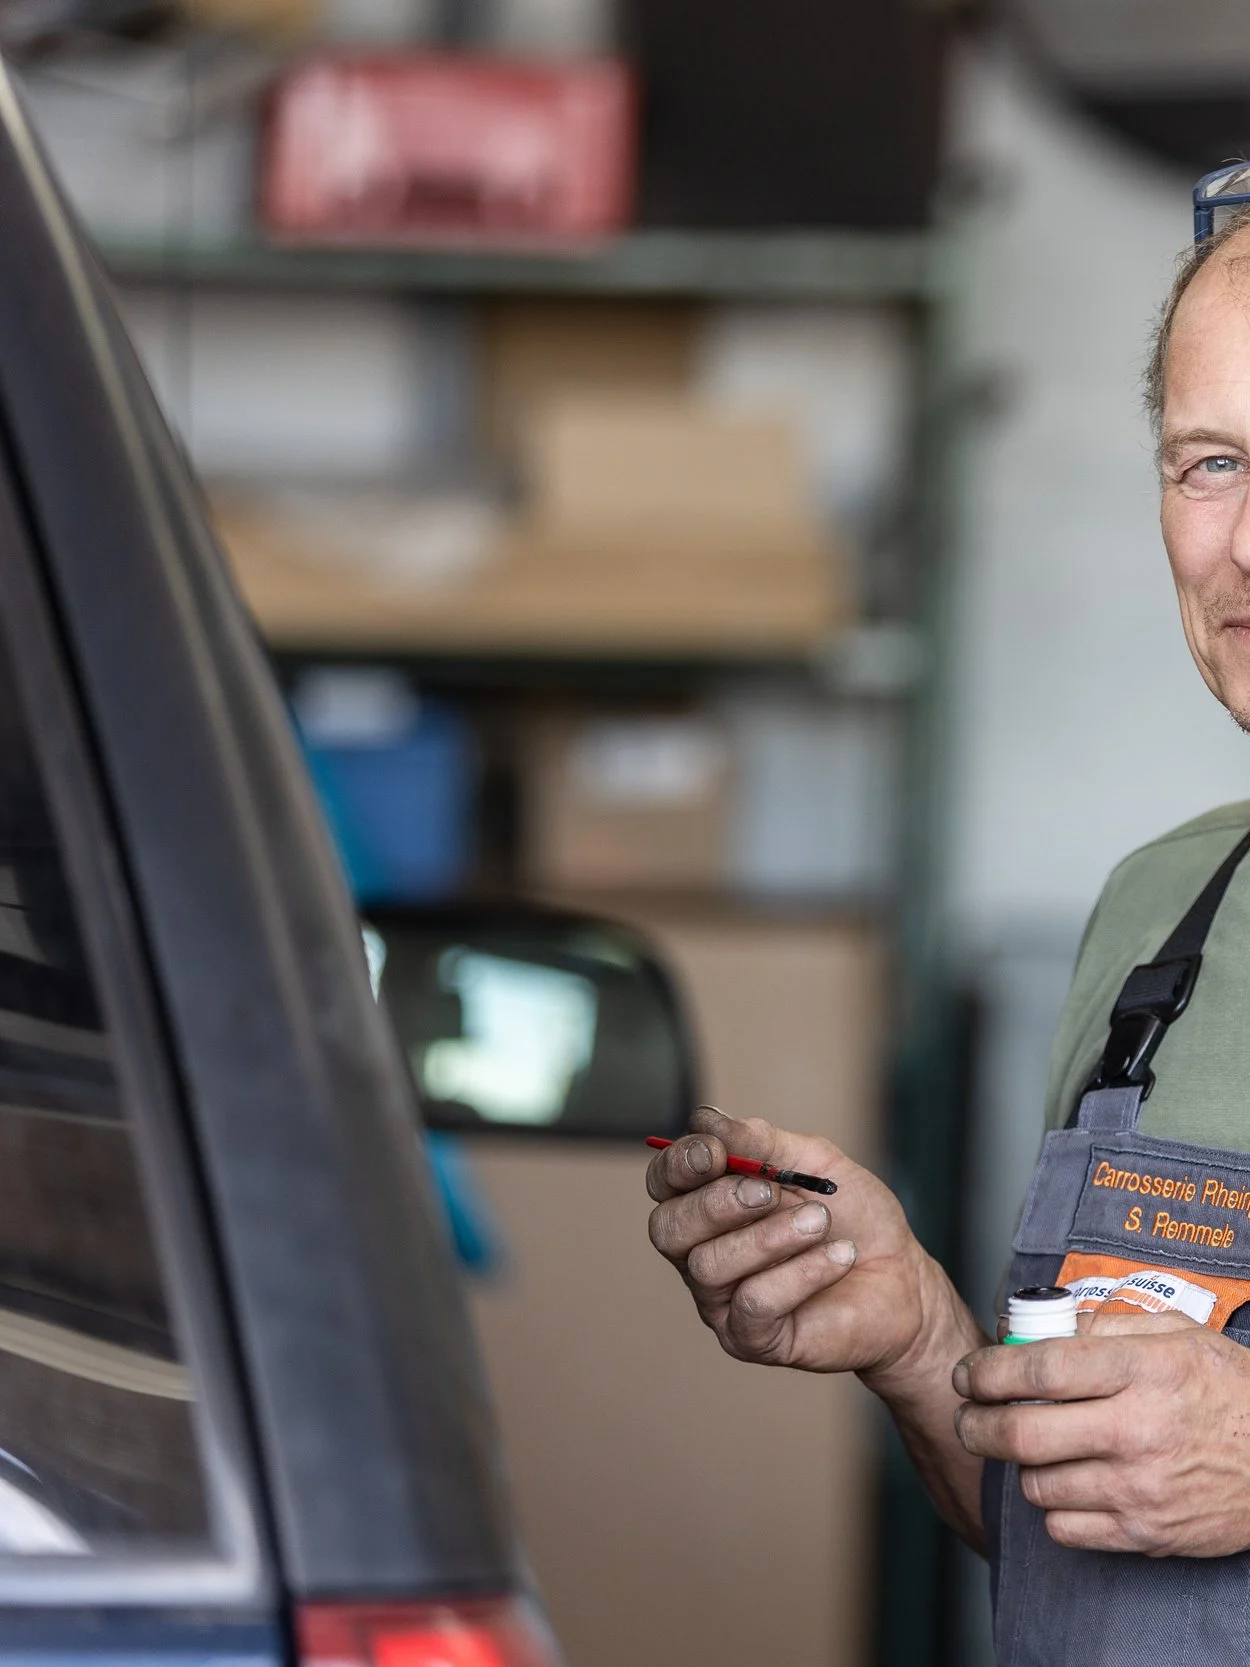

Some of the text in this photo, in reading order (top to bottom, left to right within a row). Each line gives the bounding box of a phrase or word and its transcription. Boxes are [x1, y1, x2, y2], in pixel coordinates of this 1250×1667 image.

[1093, 1161, 1196, 1202] Carrosserie
[1124, 1205, 1235, 1248] S. Remmele
[1127, 1277, 1176, 1299] suisse
